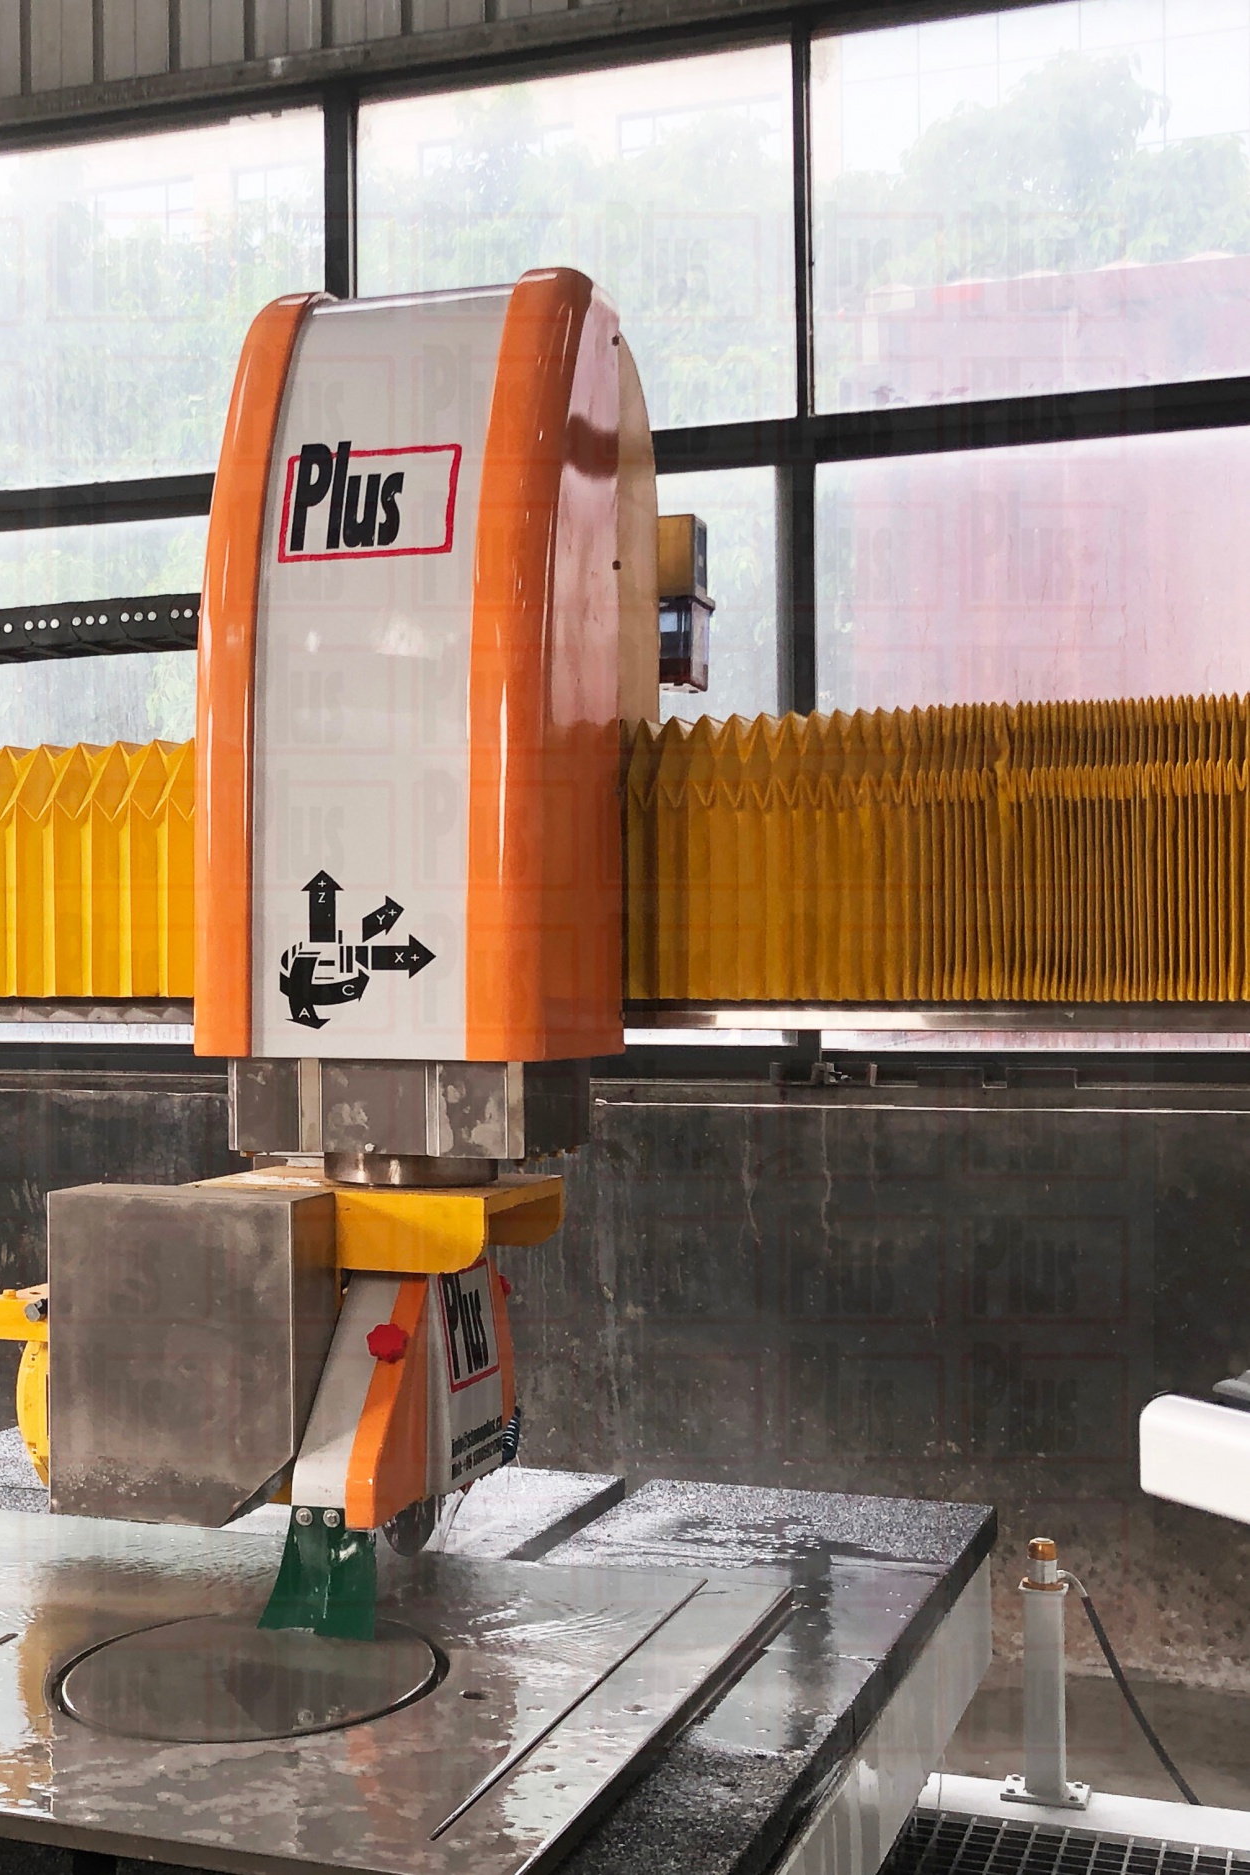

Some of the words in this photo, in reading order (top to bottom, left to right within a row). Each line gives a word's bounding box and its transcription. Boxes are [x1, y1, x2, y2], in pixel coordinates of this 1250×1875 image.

[290, 441, 404, 551] Plus
[298, 1007, 311, 1018] A
[342, 984, 355, 996] C
[442, 1271, 489, 1380] Plus
